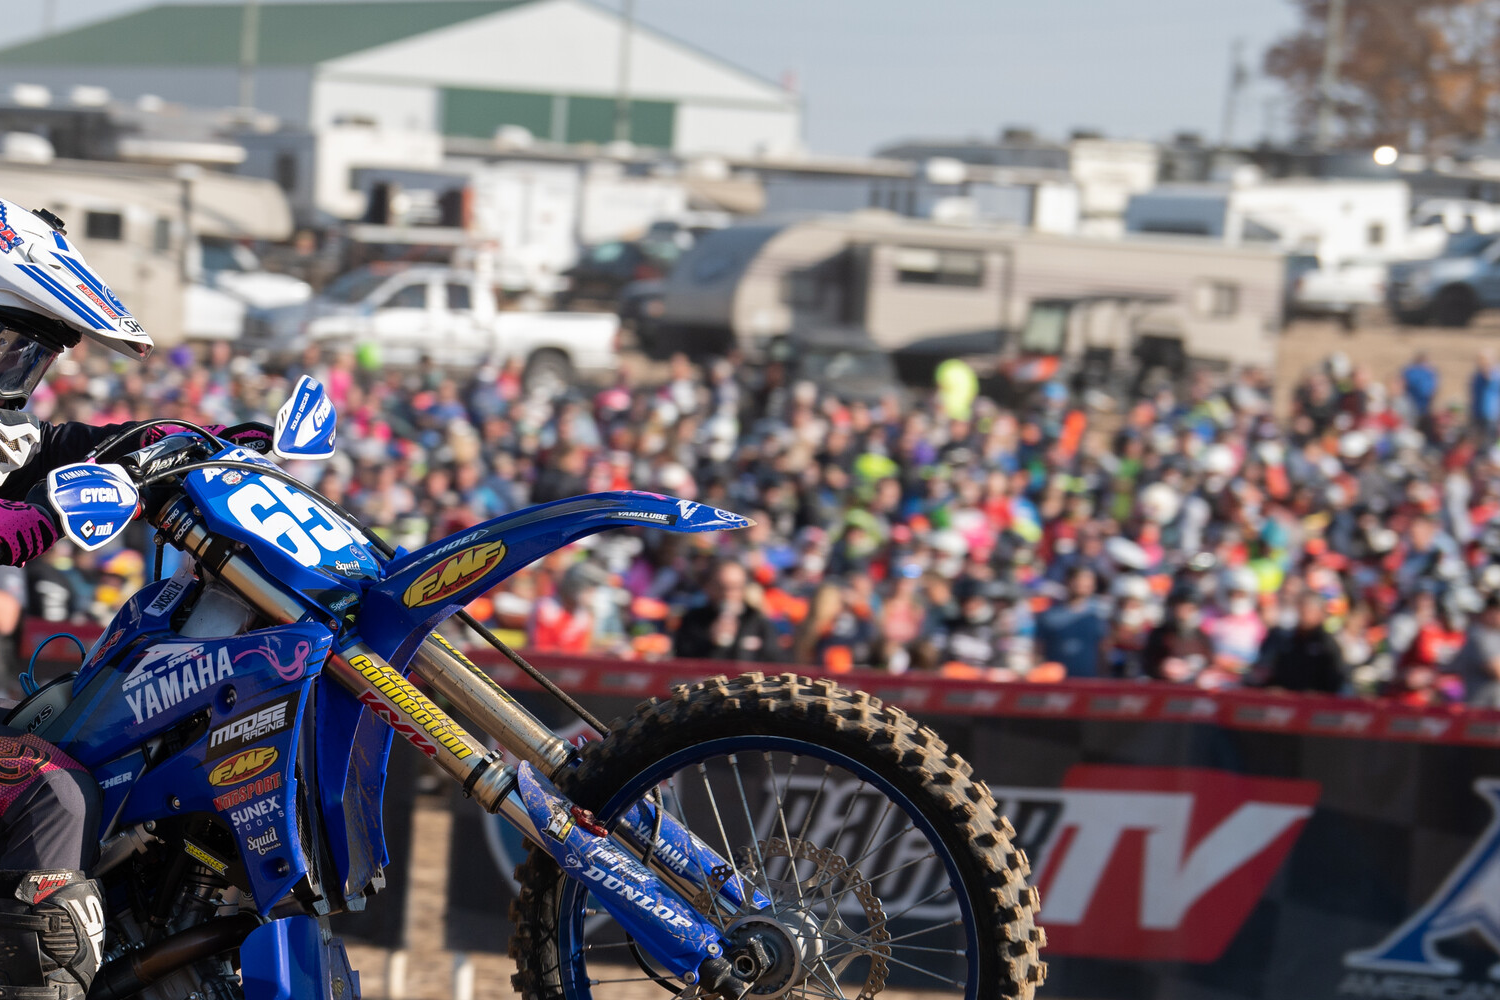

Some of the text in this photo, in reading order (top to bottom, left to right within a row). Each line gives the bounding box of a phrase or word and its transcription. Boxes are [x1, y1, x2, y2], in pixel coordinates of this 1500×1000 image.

[59, 469, 92, 481] YAMAHA
[80, 488, 119, 504] CYCRA
[161, 508, 180, 531] XTRIG
[227, 475, 372, 568] 65
[617, 511, 669, 521] YAMALUBE
[335, 560, 362, 576] Squid
[408, 539, 503, 608] FMF
[125, 646, 234, 725] YAMAHA
[349, 654, 474, 760] Connection
[210, 701, 289, 749] MOOSE
[242, 718, 286, 743] RACING
[212, 746, 276, 786] FMF
[231, 795, 281, 826] SUNEX
[235, 810, 285, 835] TOOLS
[247, 826, 279, 856] Squid
[582, 864, 693, 928] DUNLOP
